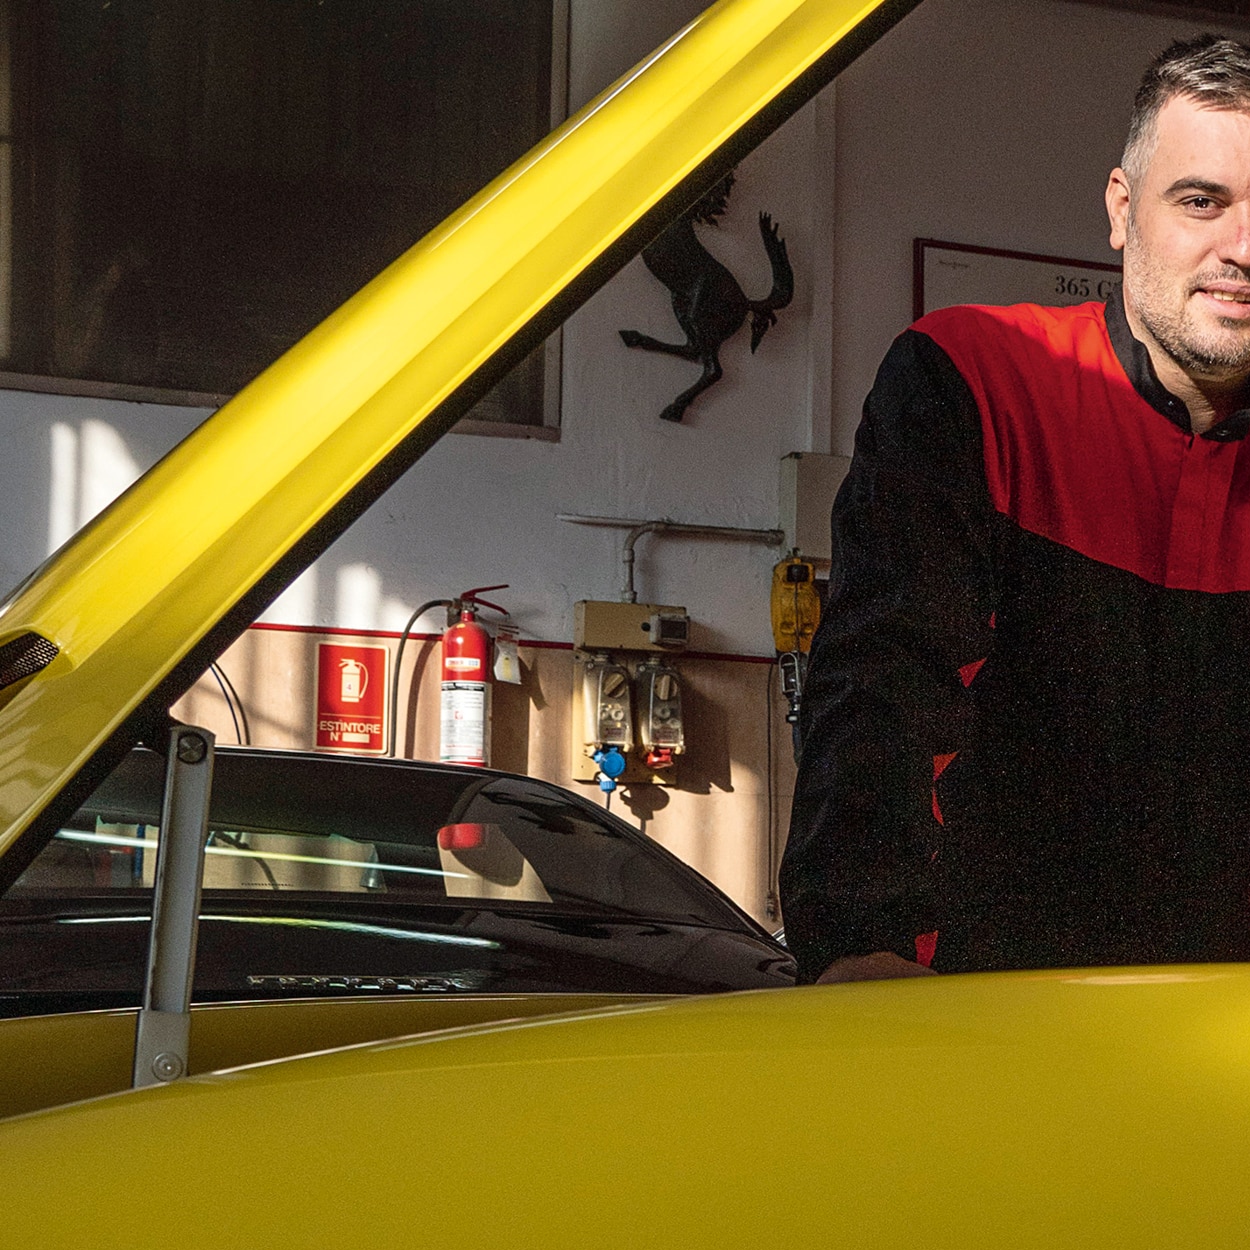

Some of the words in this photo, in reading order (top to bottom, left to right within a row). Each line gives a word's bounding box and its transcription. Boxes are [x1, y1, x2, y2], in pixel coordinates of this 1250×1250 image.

[1055, 275, 1090, 298] 365
[1097, 279, 1123, 299] G
[320, 720, 381, 734] ESTINTORE
